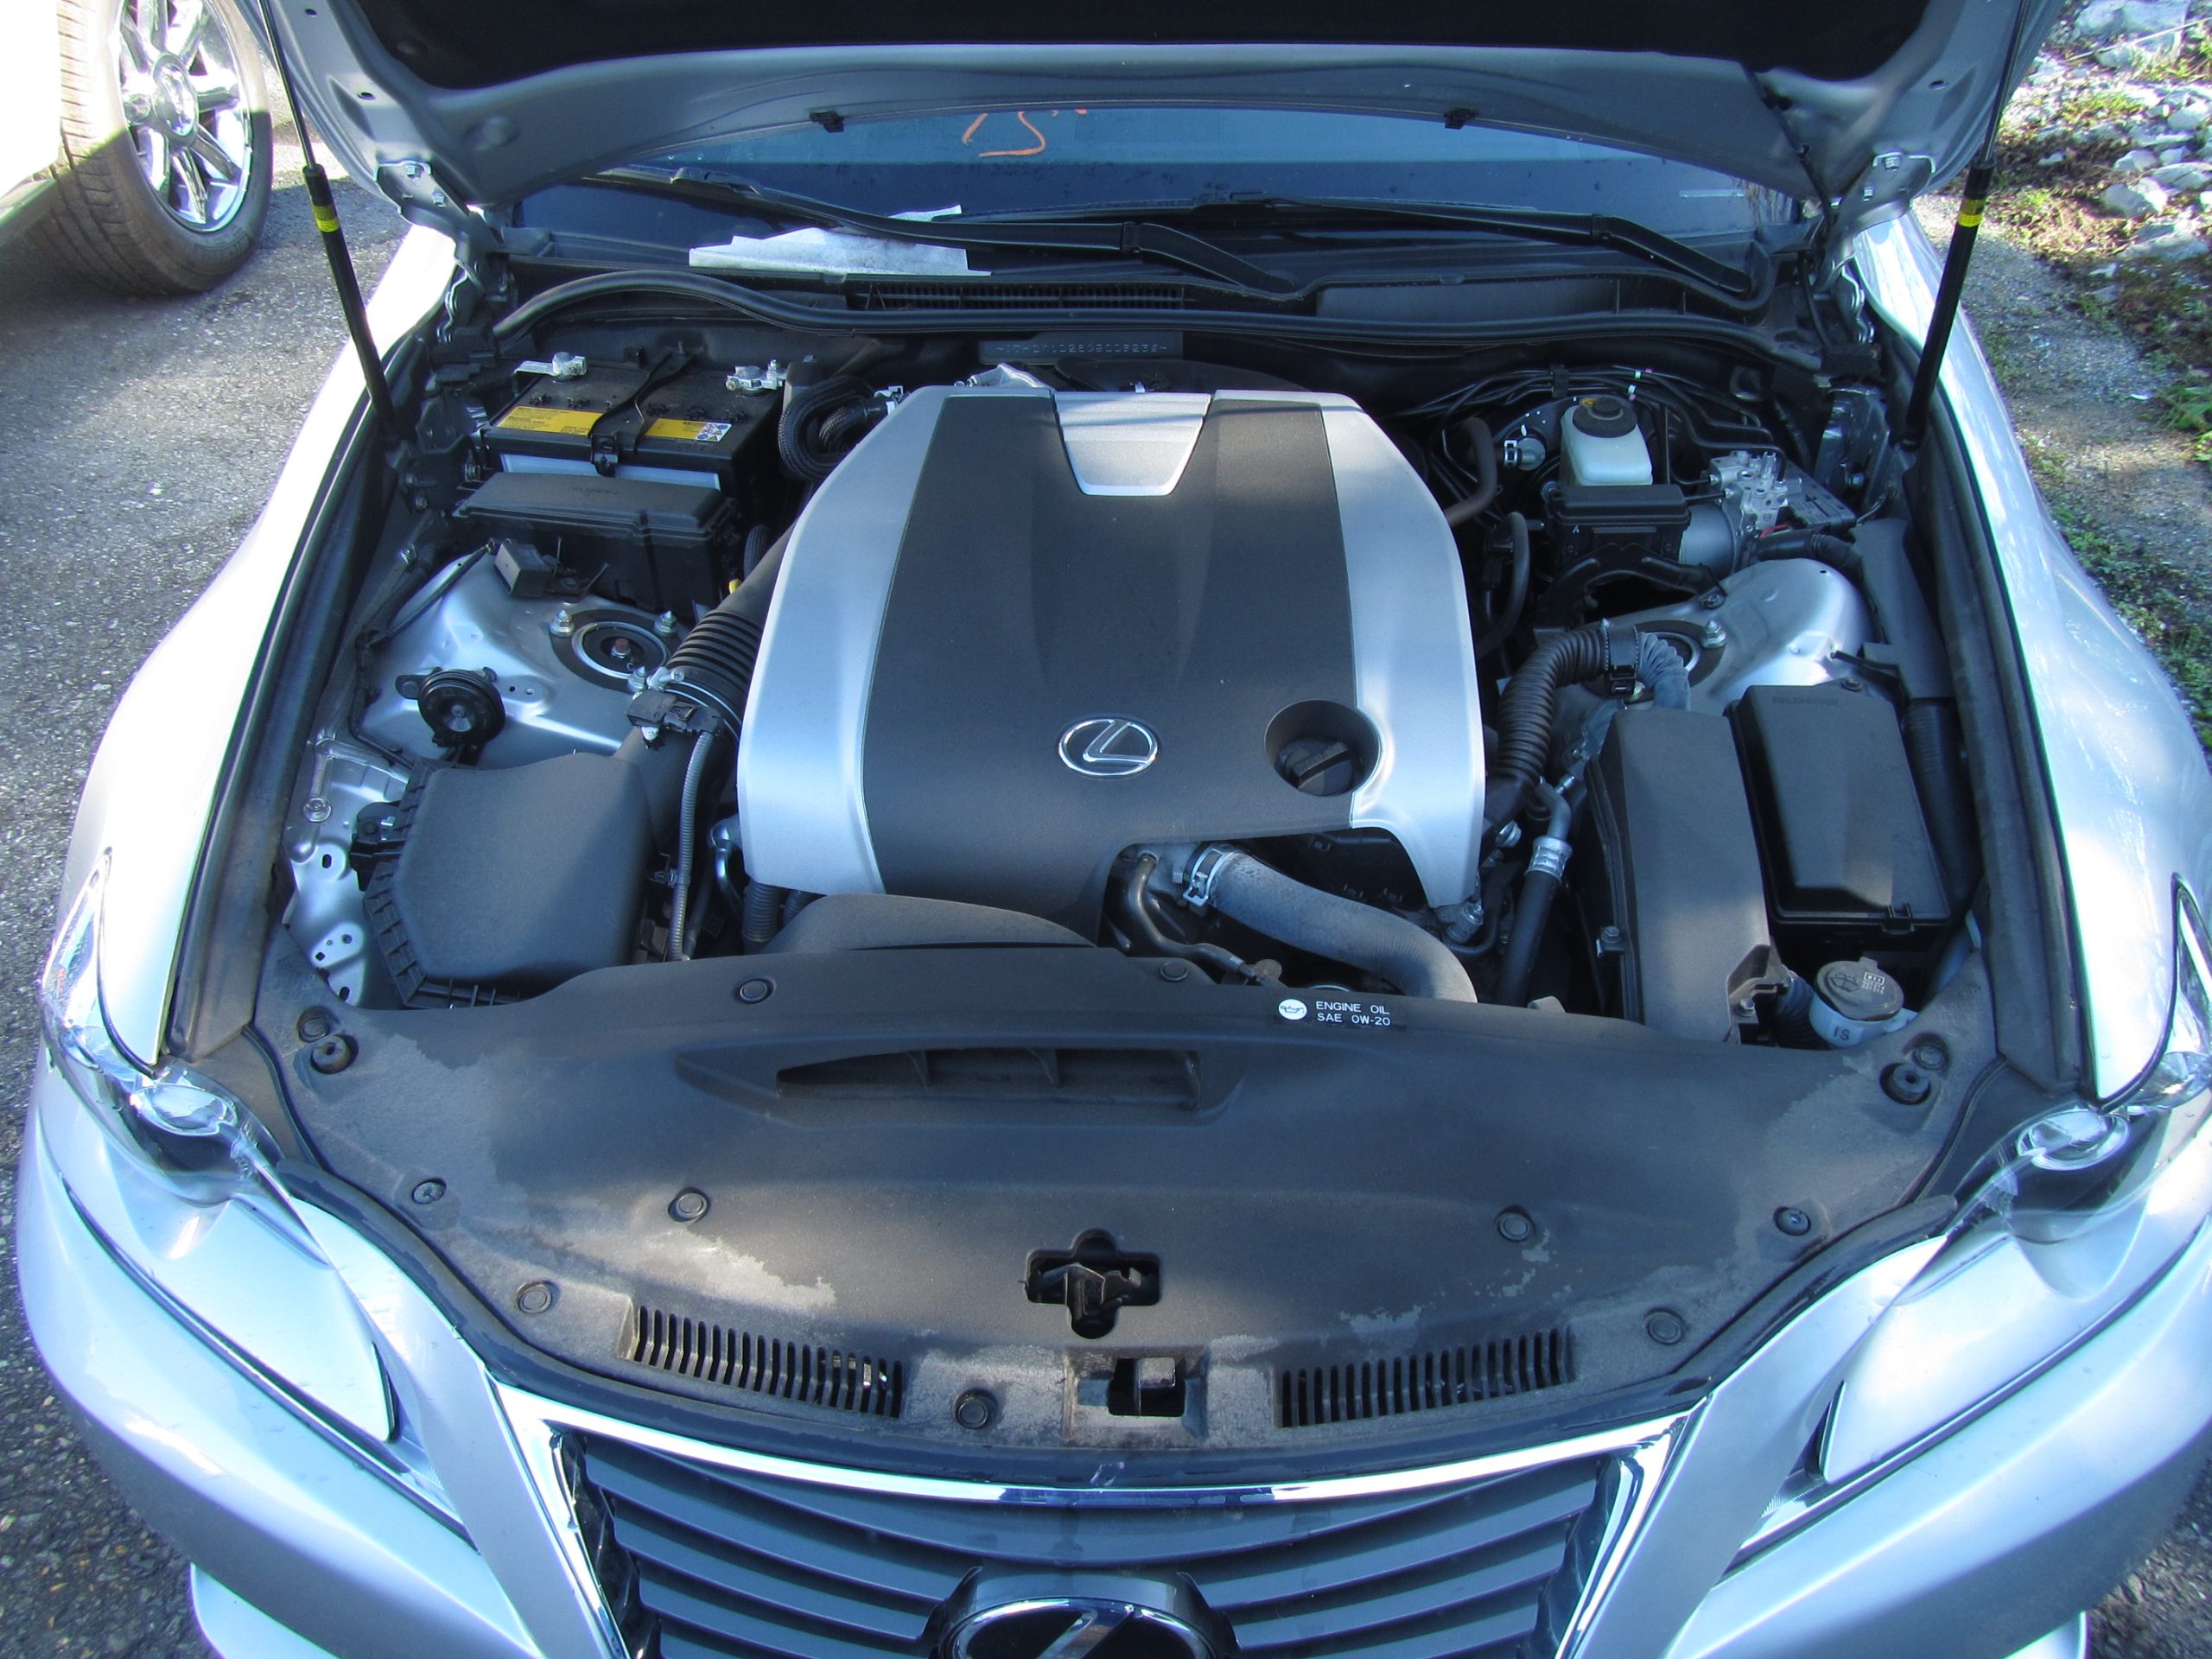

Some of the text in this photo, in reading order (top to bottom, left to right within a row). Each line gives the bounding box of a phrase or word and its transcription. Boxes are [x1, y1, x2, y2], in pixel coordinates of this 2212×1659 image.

[1315, 1001, 1390, 1014] ENGINE OIL
[1316, 1013, 1391, 1026] SAE 0W-20
[1833, 1026, 1851, 1041] IS
